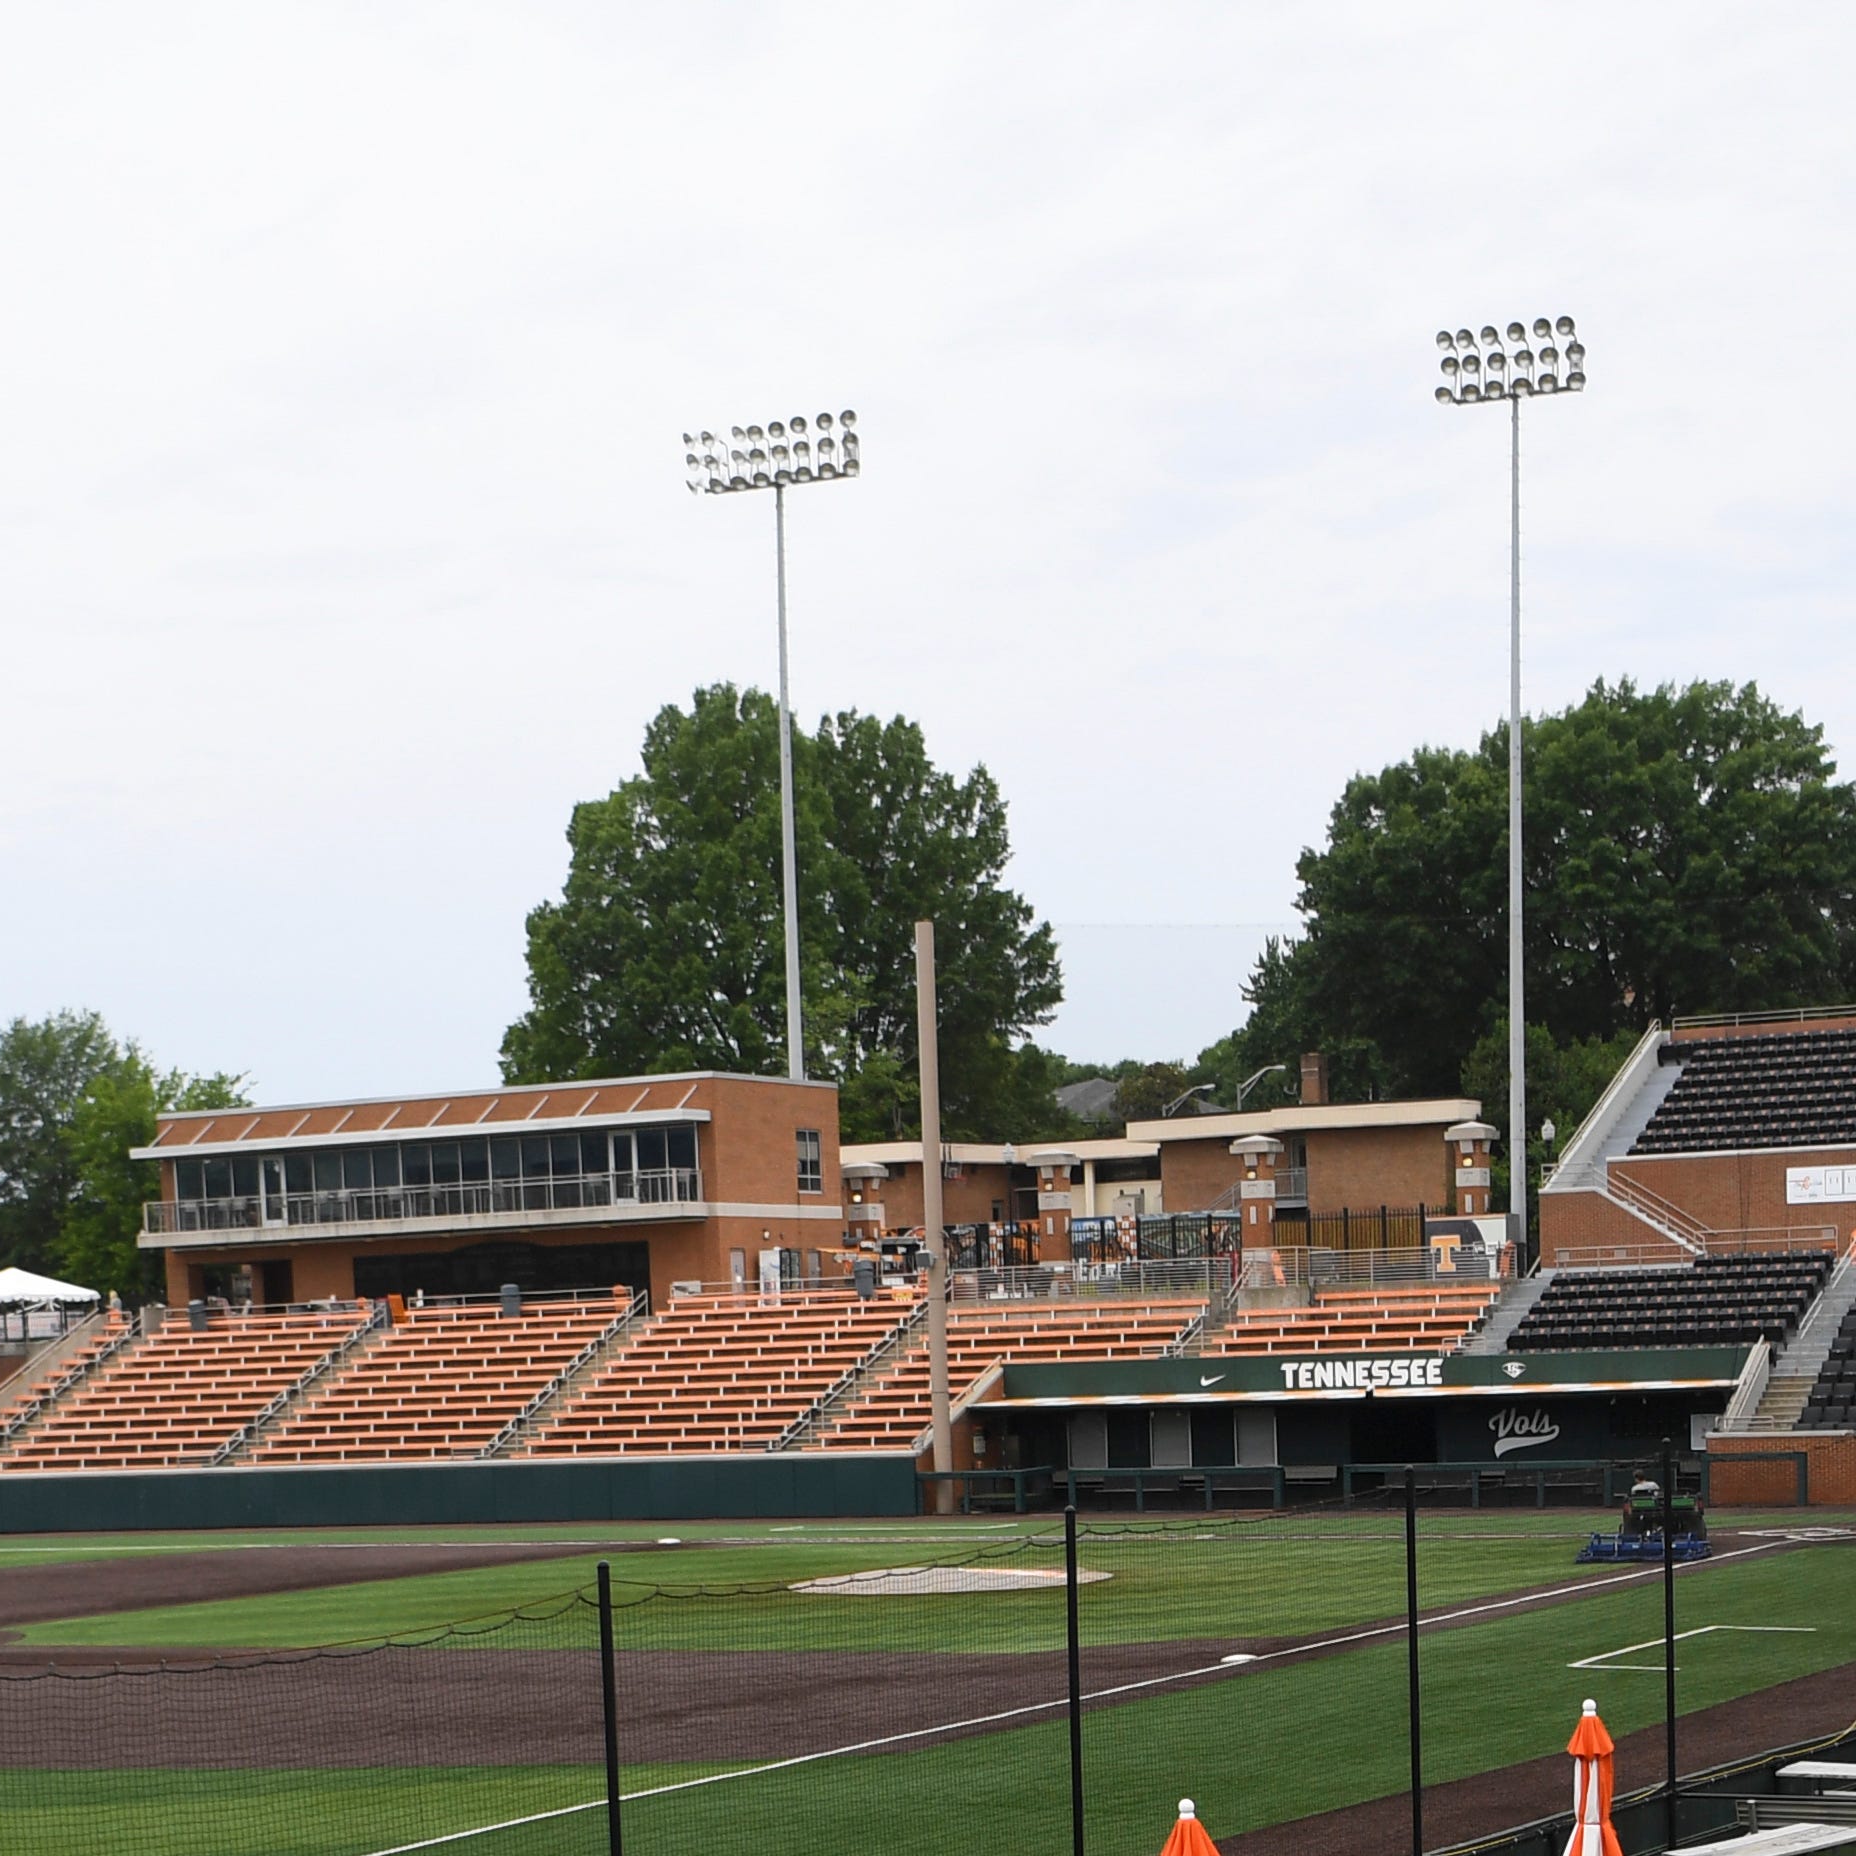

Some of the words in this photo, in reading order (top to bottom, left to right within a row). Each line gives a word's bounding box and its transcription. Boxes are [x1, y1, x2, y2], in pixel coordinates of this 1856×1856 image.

[1430, 1234, 1461, 1273] T
[1280, 1358, 1444, 1389] TENNESSEE
[1488, 1408, 1559, 1448] Vols
